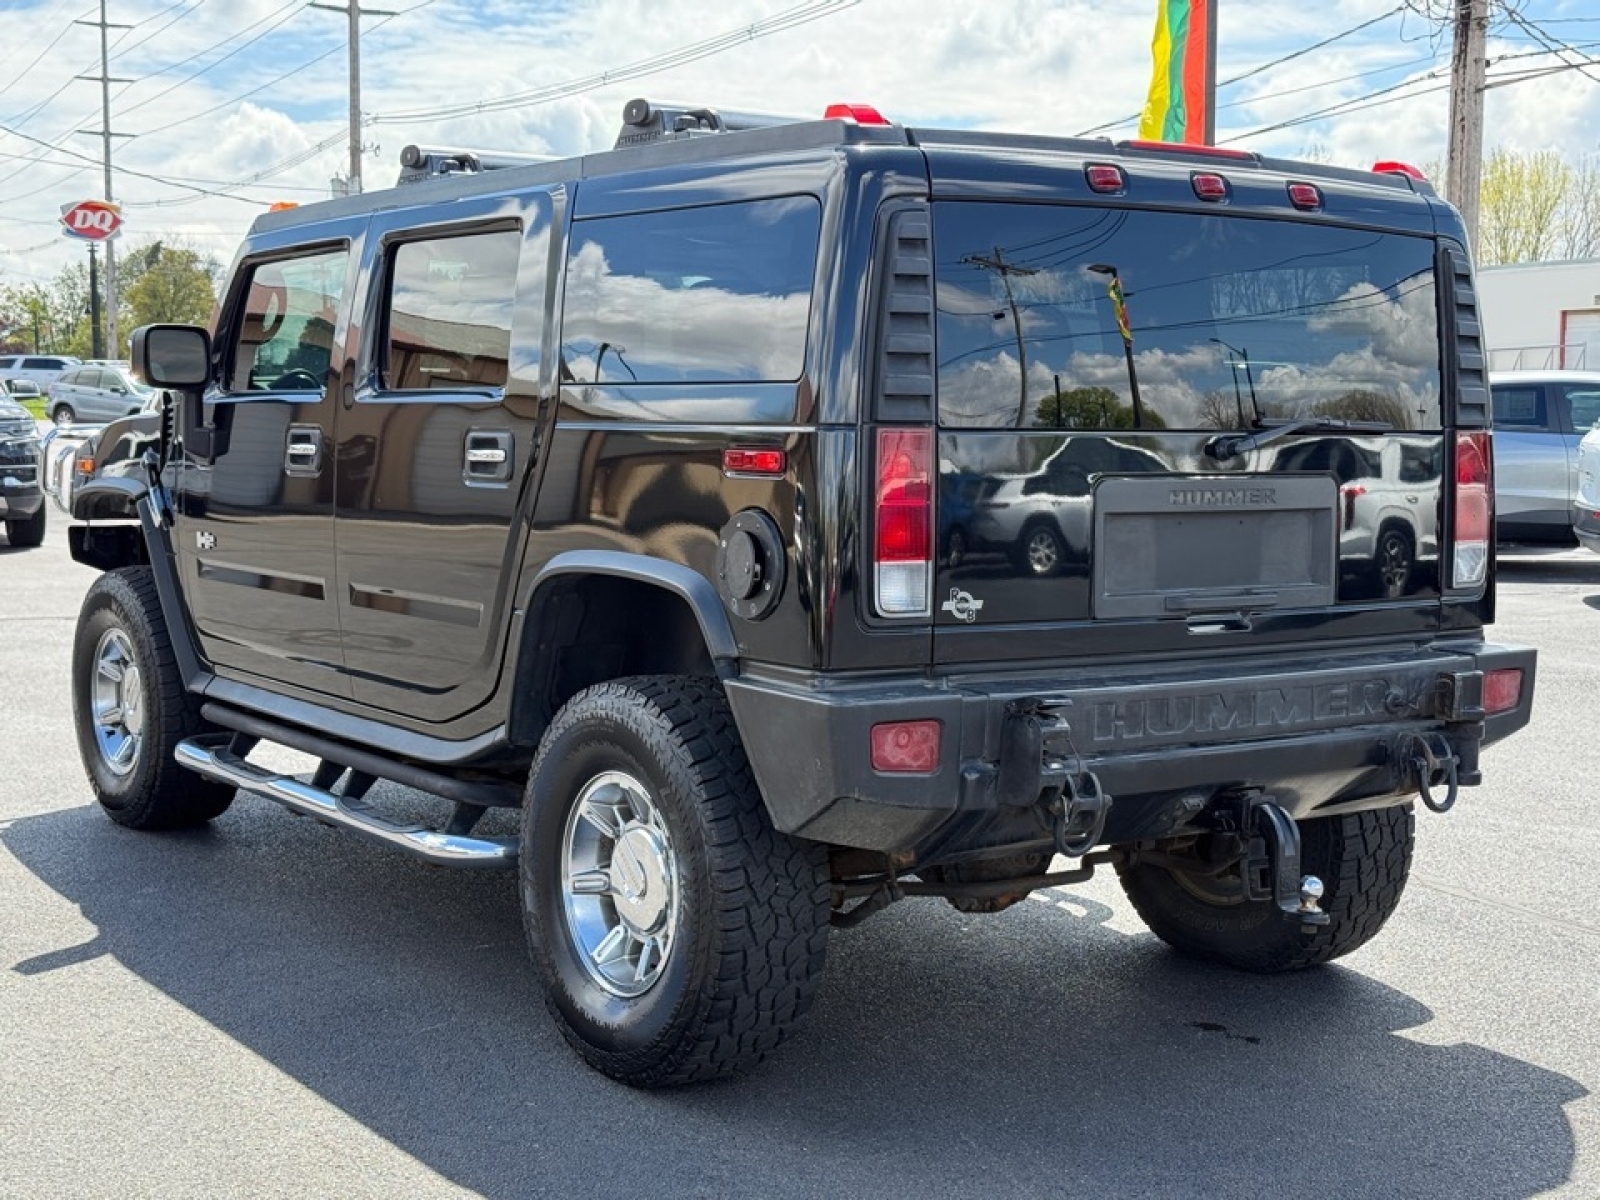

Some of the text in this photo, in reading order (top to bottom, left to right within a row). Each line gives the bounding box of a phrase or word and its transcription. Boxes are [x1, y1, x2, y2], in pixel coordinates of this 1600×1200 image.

[73, 209, 113, 232] DQ
[1168, 487, 1277, 505] HUMMER
[1093, 679, 1389, 740] HUMMER
